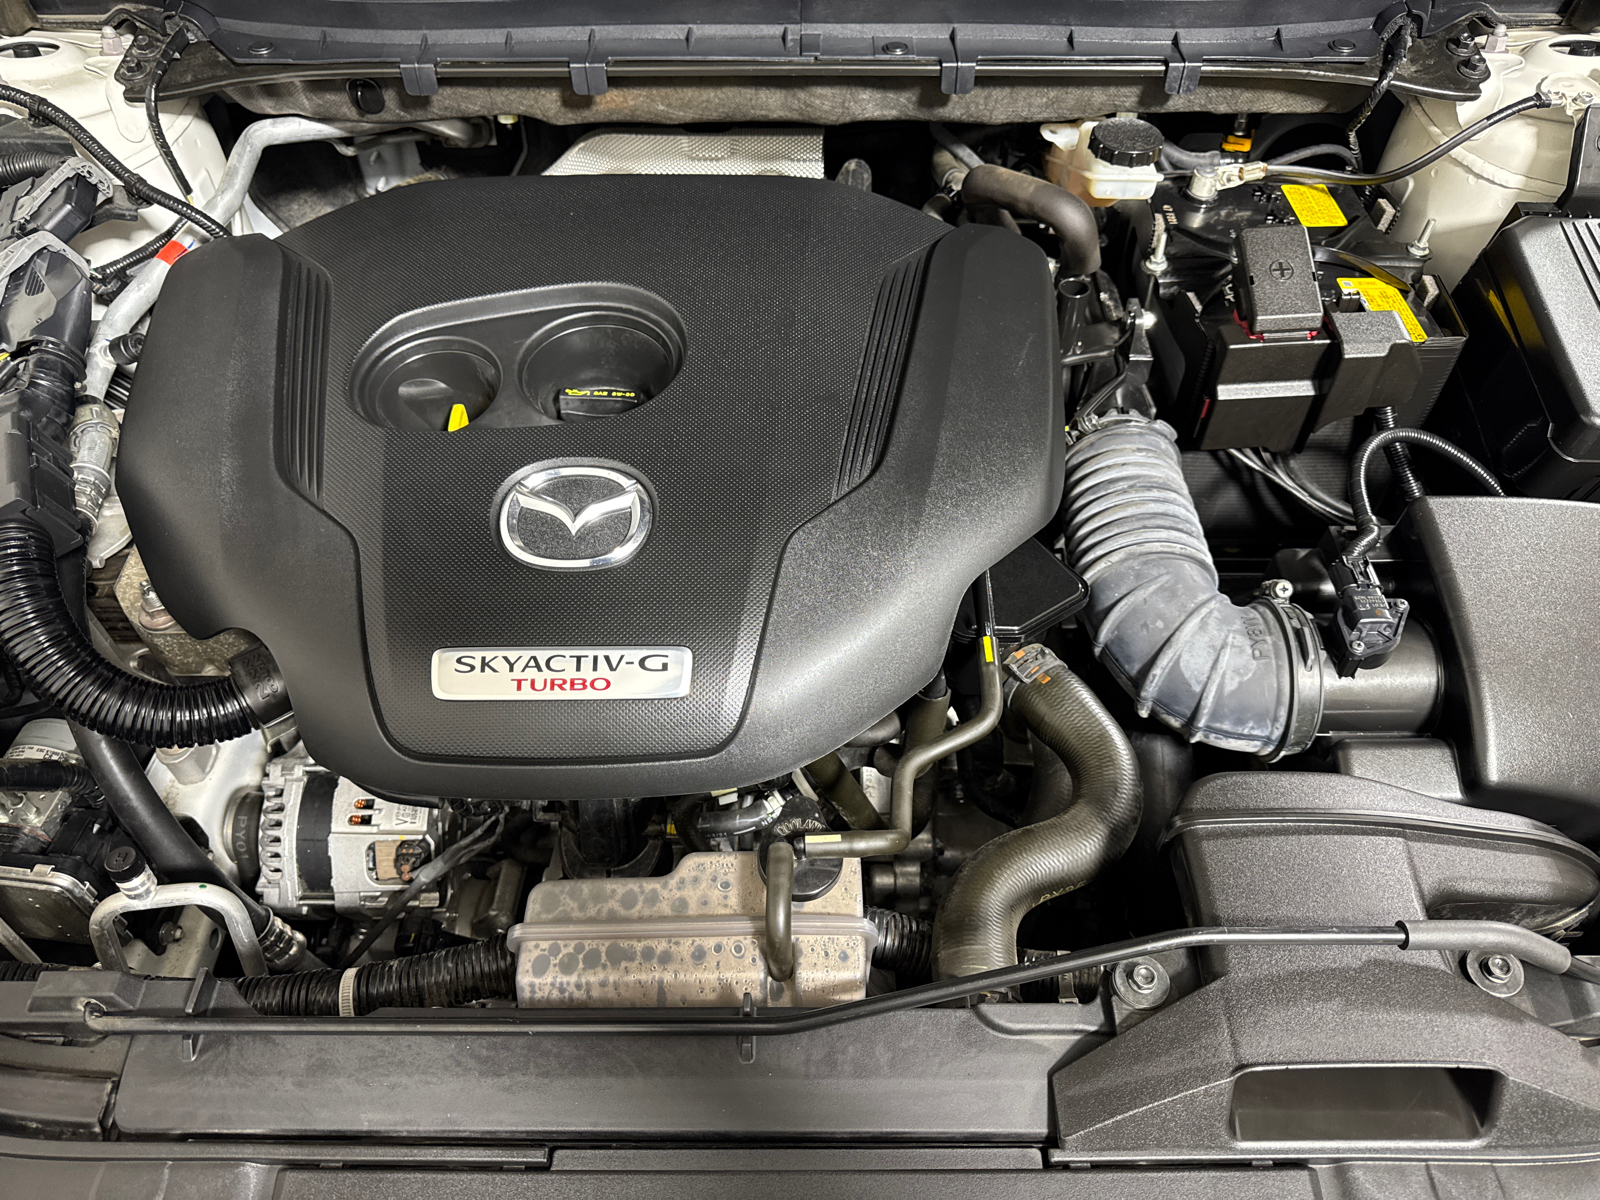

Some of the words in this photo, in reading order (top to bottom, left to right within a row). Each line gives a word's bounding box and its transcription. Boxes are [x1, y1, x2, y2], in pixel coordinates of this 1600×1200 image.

[453, 653, 669, 674] SKYACTIV-G
[255, 676, 279, 701] 28
[510, 676, 612, 693] TURBO
[775, 817, 826, 836] COOLANT
[114, 852, 128, 864] H
